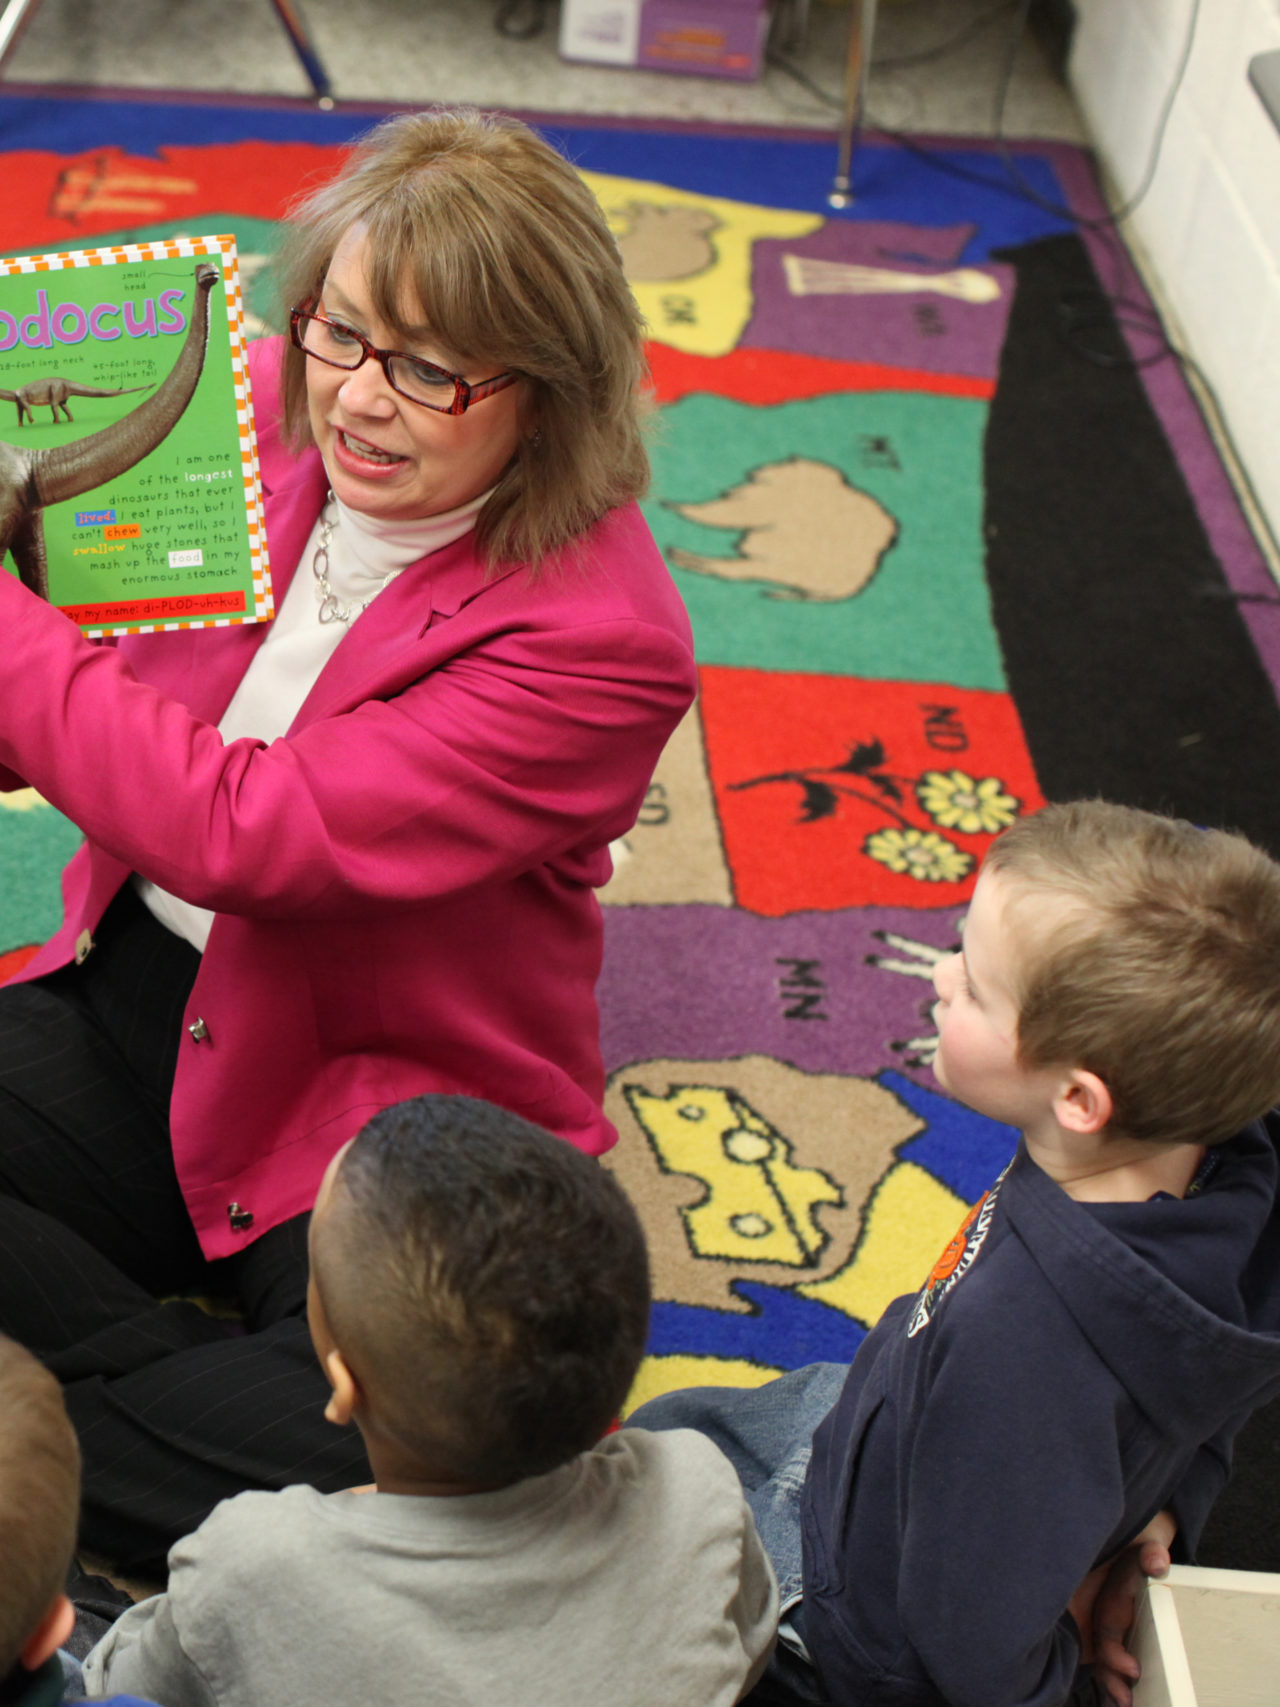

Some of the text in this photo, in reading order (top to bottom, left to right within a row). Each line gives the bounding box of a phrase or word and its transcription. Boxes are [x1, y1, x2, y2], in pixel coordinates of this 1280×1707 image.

[38, 359, 59, 371] long
[63, 356, 84, 365] neck
[142, 369, 157, 378] tail
[186, 456, 203, 464] am
[208, 453, 230, 462] one
[138, 469, 233, 486] of the longest
[109, 486, 234, 505] dinosaurs that ever
[77, 511, 115, 525] lived.
[131, 509, 150, 519] eat
[156, 505, 199, 519] plants,
[204, 502, 224, 513] but
[72, 528, 101, 541] can't
[107, 527, 138, 538] chew
[144, 523, 171, 535] very
[177, 520, 208, 531] well,
[213, 519, 226, 528] so
[73, 532, 238, 556] swallow huge stones that
[89, 551, 240, 571] mash up the food in my
[121, 566, 237, 585] enormous stomach
[62, 597, 239, 621] ay my name: di-PLOD-uh-kus
[920, 703, 969, 753] ND
[776, 958, 829, 1021] MN
